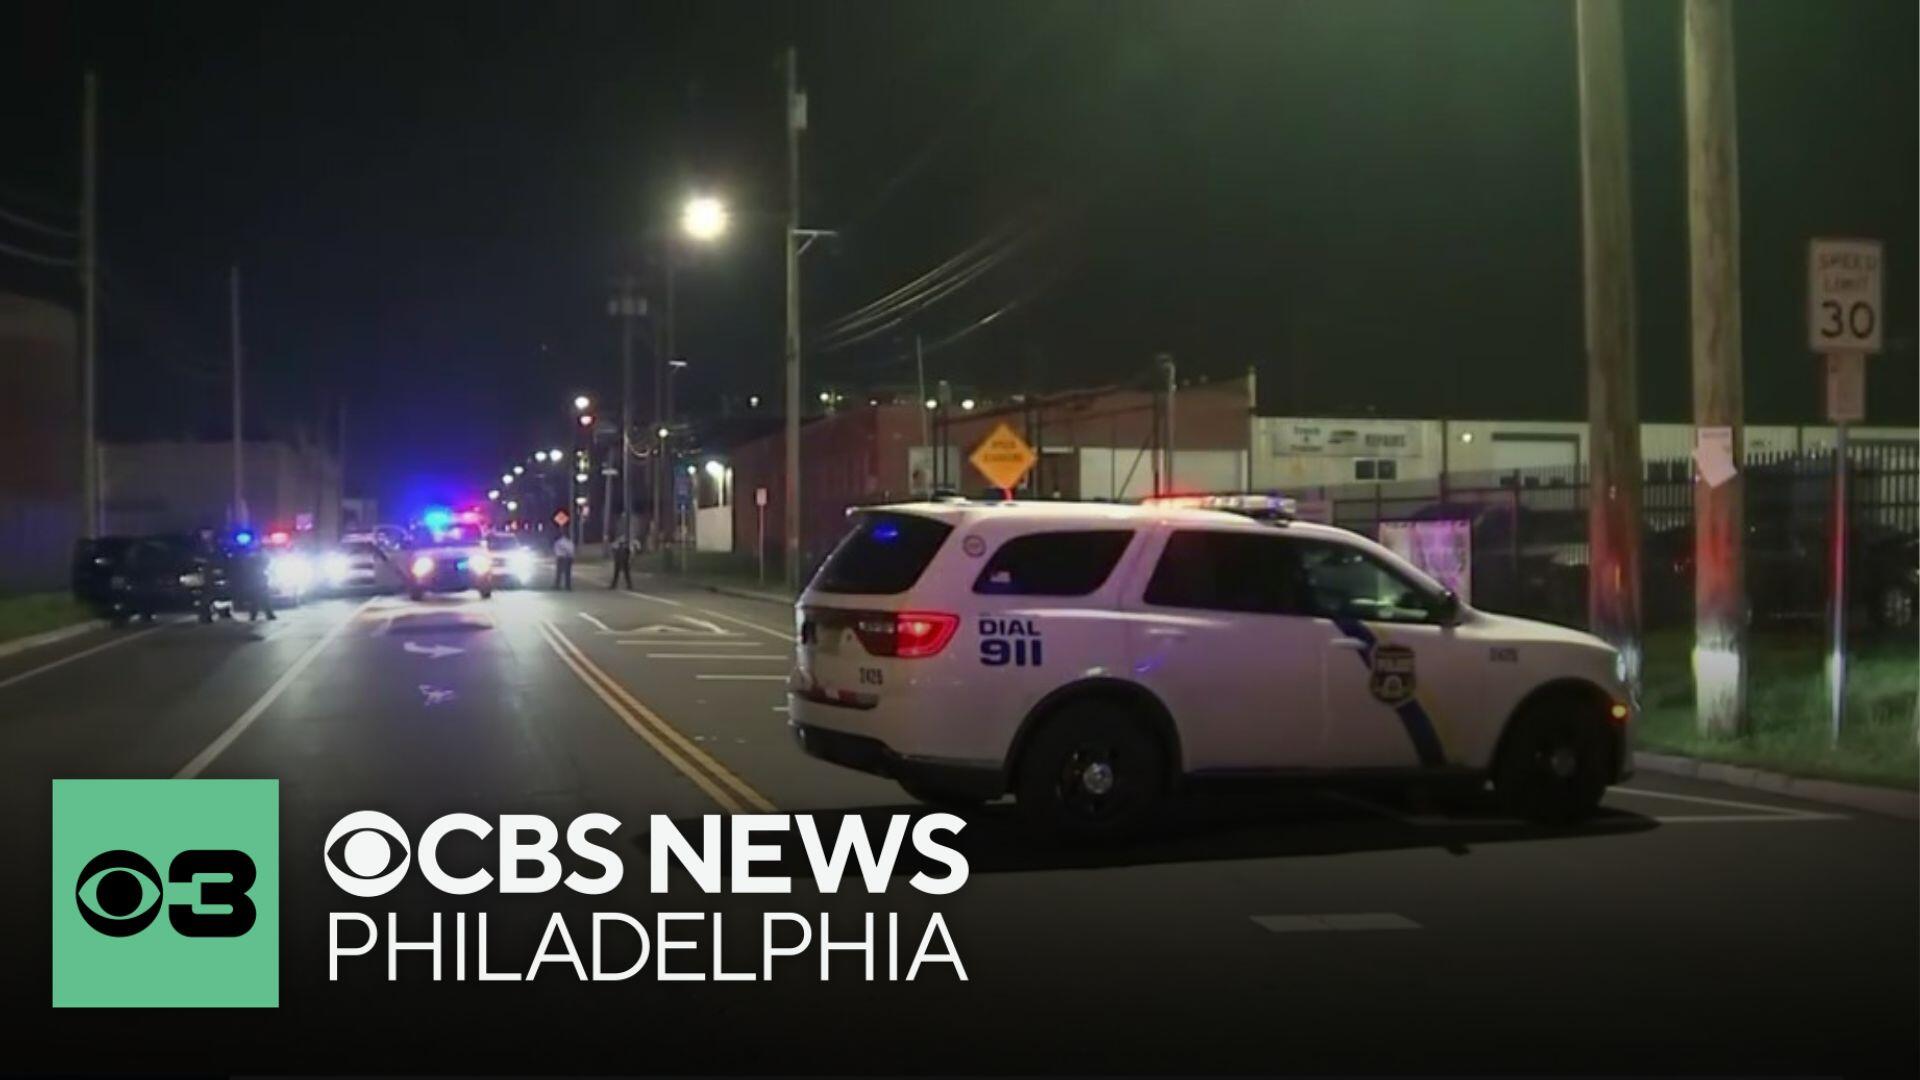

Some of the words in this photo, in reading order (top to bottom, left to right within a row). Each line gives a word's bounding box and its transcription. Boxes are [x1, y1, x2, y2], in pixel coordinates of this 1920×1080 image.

[1820, 300, 1876, 339] 30
[979, 619, 1041, 636] DIAL
[980, 638, 1042, 667] 911
